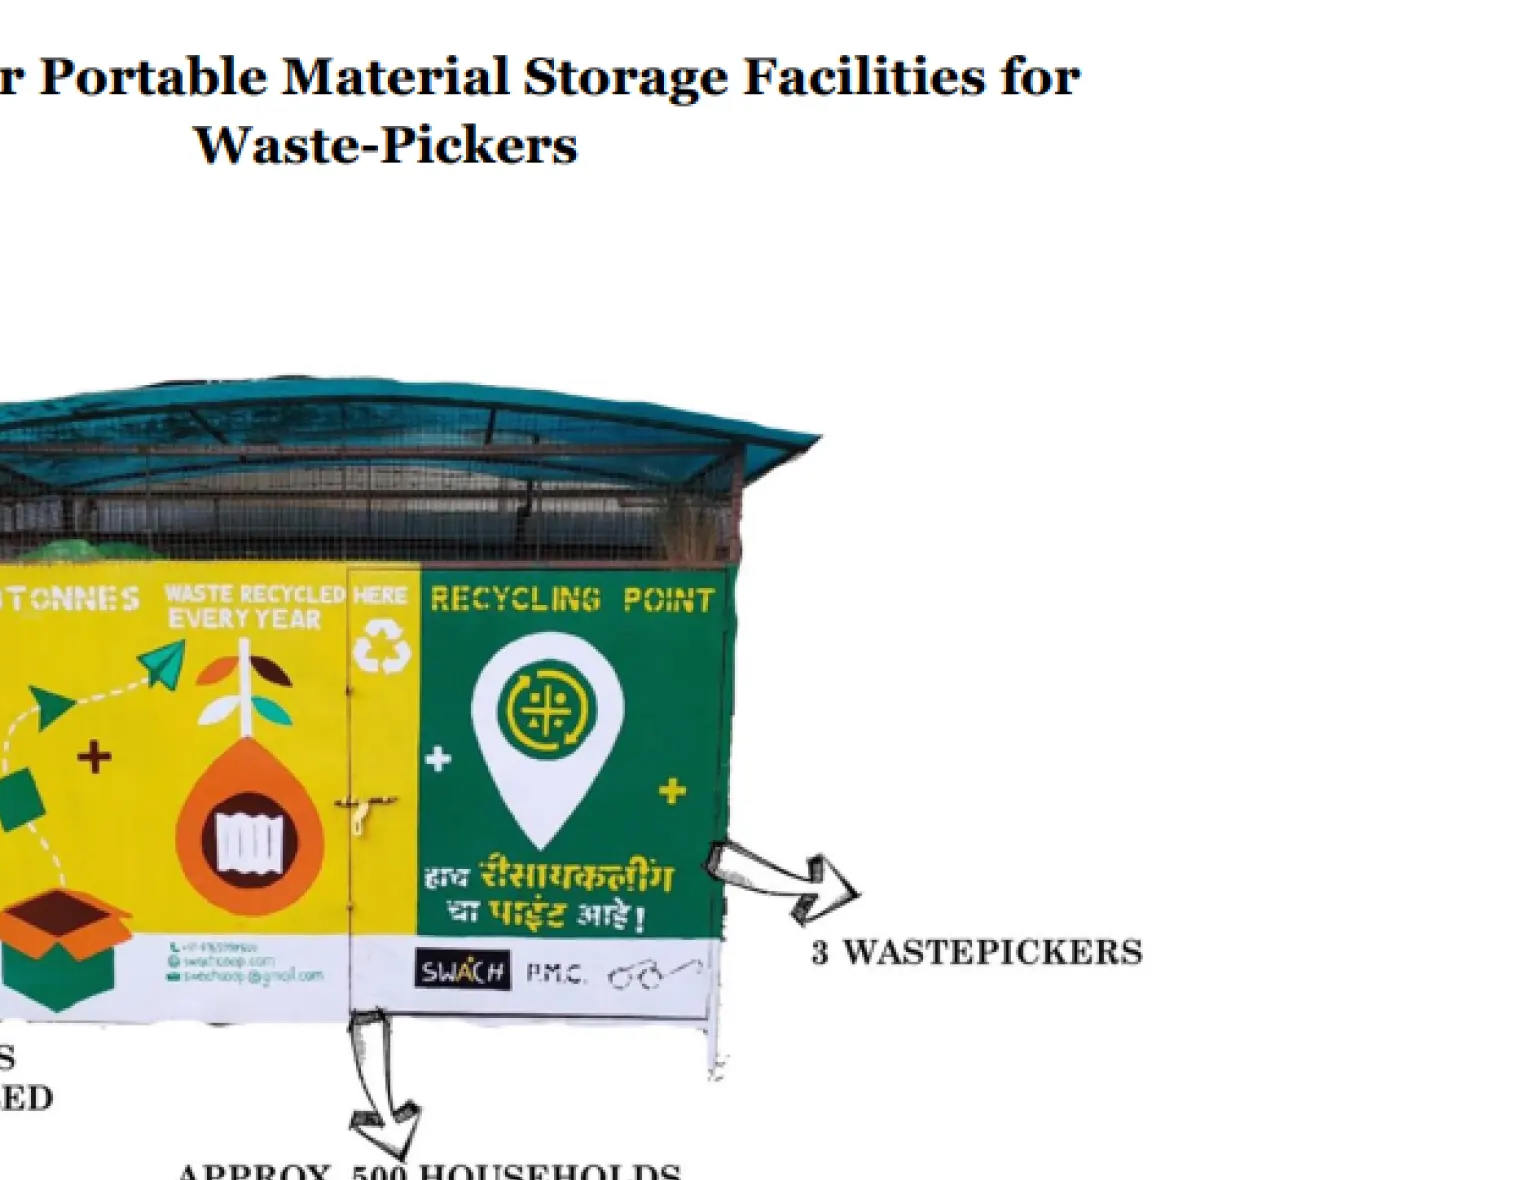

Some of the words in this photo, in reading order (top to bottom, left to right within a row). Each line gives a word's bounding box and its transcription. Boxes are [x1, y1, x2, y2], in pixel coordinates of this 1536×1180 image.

[164, 584, 233, 604] WASTE
[240, 584, 345, 605] RECYCLED
[354, 585, 409, 606] HERE
[430, 585, 602, 613] RECYCLING
[623, 586, 716, 614] POINT
[167, 608, 253, 630] EVERY
[258, 608, 322, 631] YEAR
